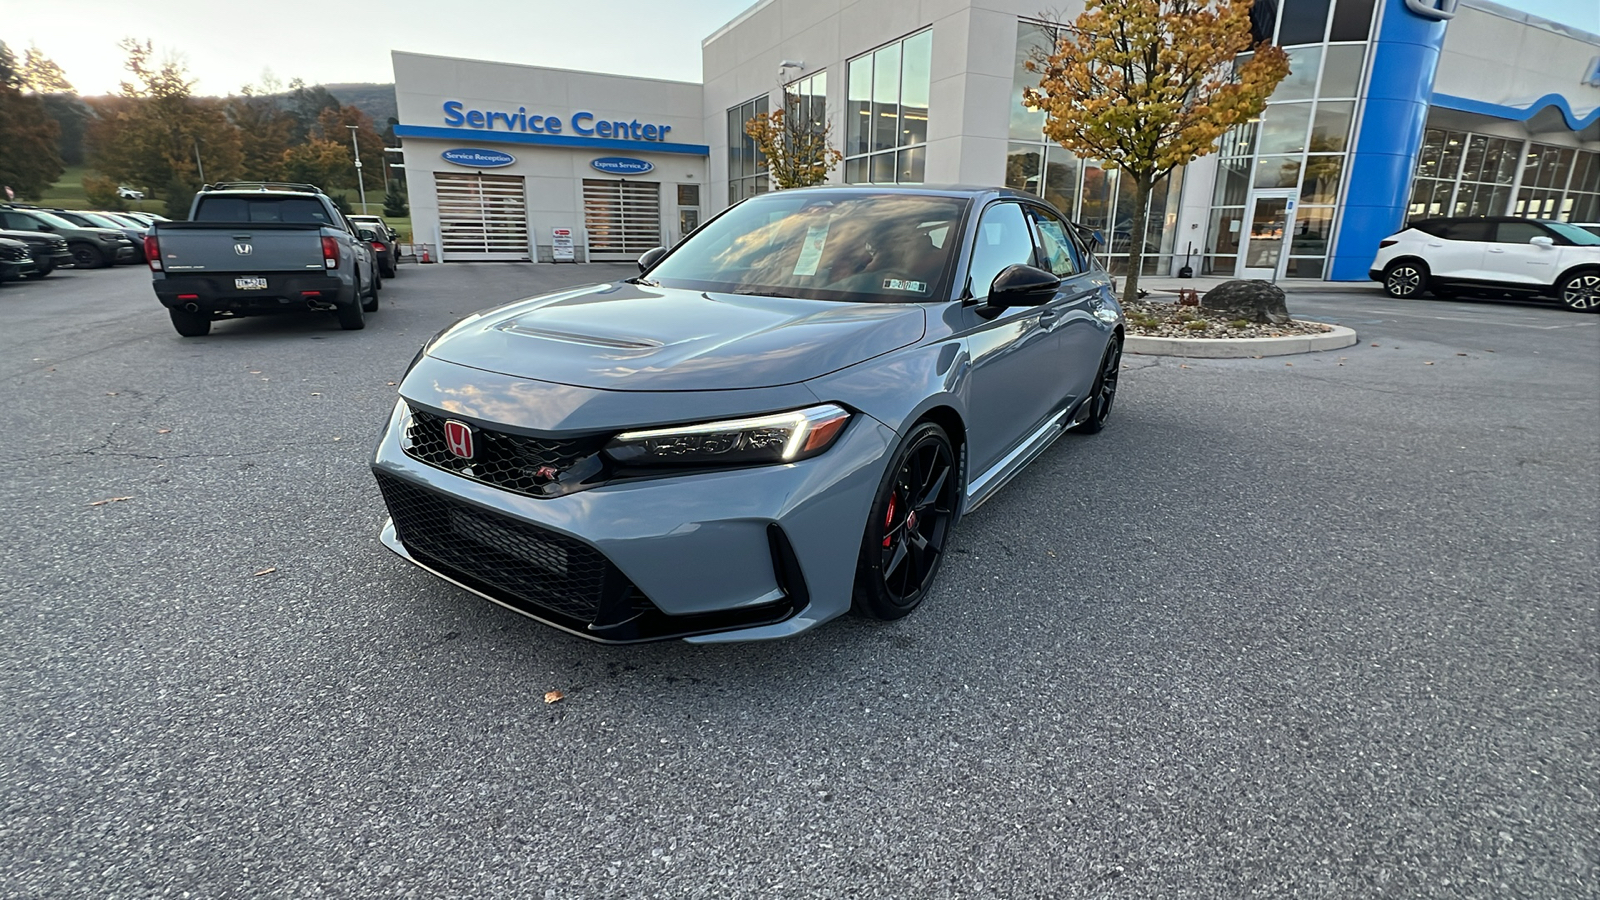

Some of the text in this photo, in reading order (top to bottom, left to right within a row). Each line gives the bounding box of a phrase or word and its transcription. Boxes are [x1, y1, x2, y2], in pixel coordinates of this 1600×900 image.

[442, 100, 672, 142] Service Center
[445, 152, 511, 162] Service Reception
[594, 160, 641, 169] Express Service
